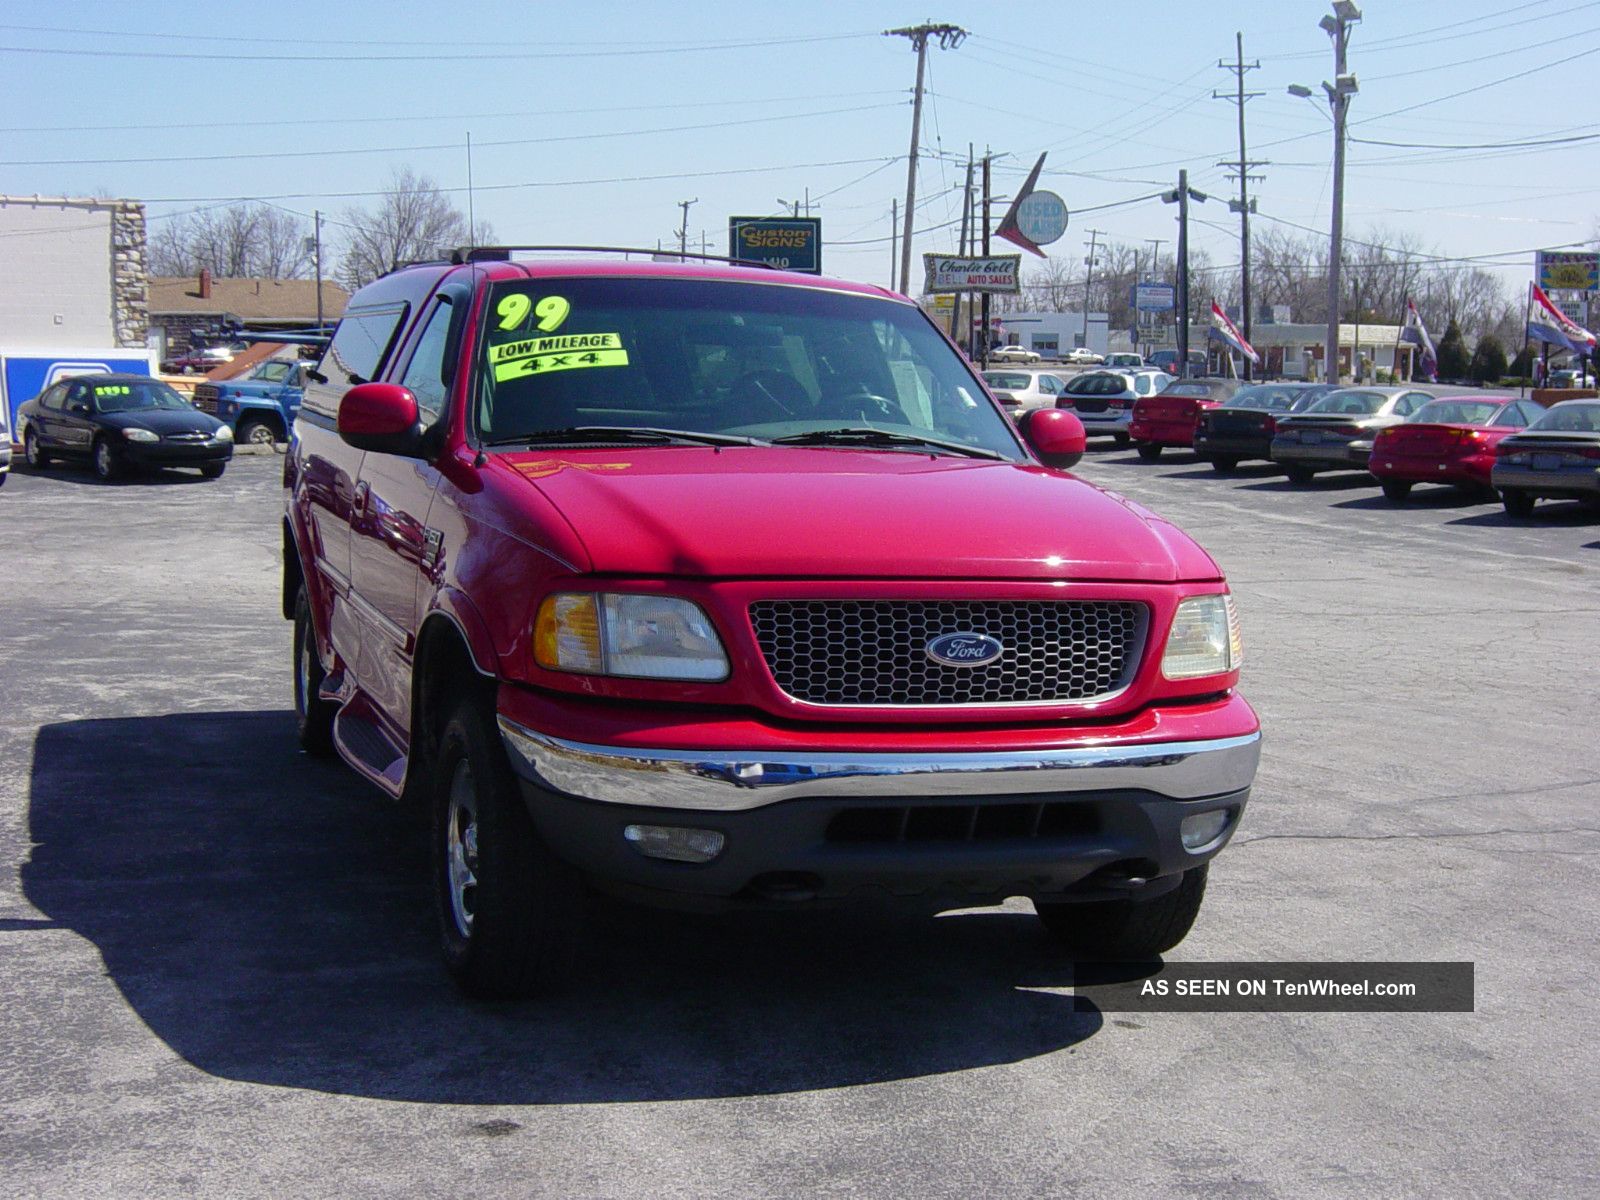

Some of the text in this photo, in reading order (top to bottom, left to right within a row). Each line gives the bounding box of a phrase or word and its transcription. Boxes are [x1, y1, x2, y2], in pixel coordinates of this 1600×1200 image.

[740, 226, 812, 238] Custom
[745, 236, 806, 248] SIGNS
[939, 260, 982, 273] Charlie
[938, 274, 1013, 285] BELL AUTO SALES
[497, 293, 571, 332] 99
[497, 334, 614, 359] LOW MILEAGE
[947, 639, 986, 657] Ford
